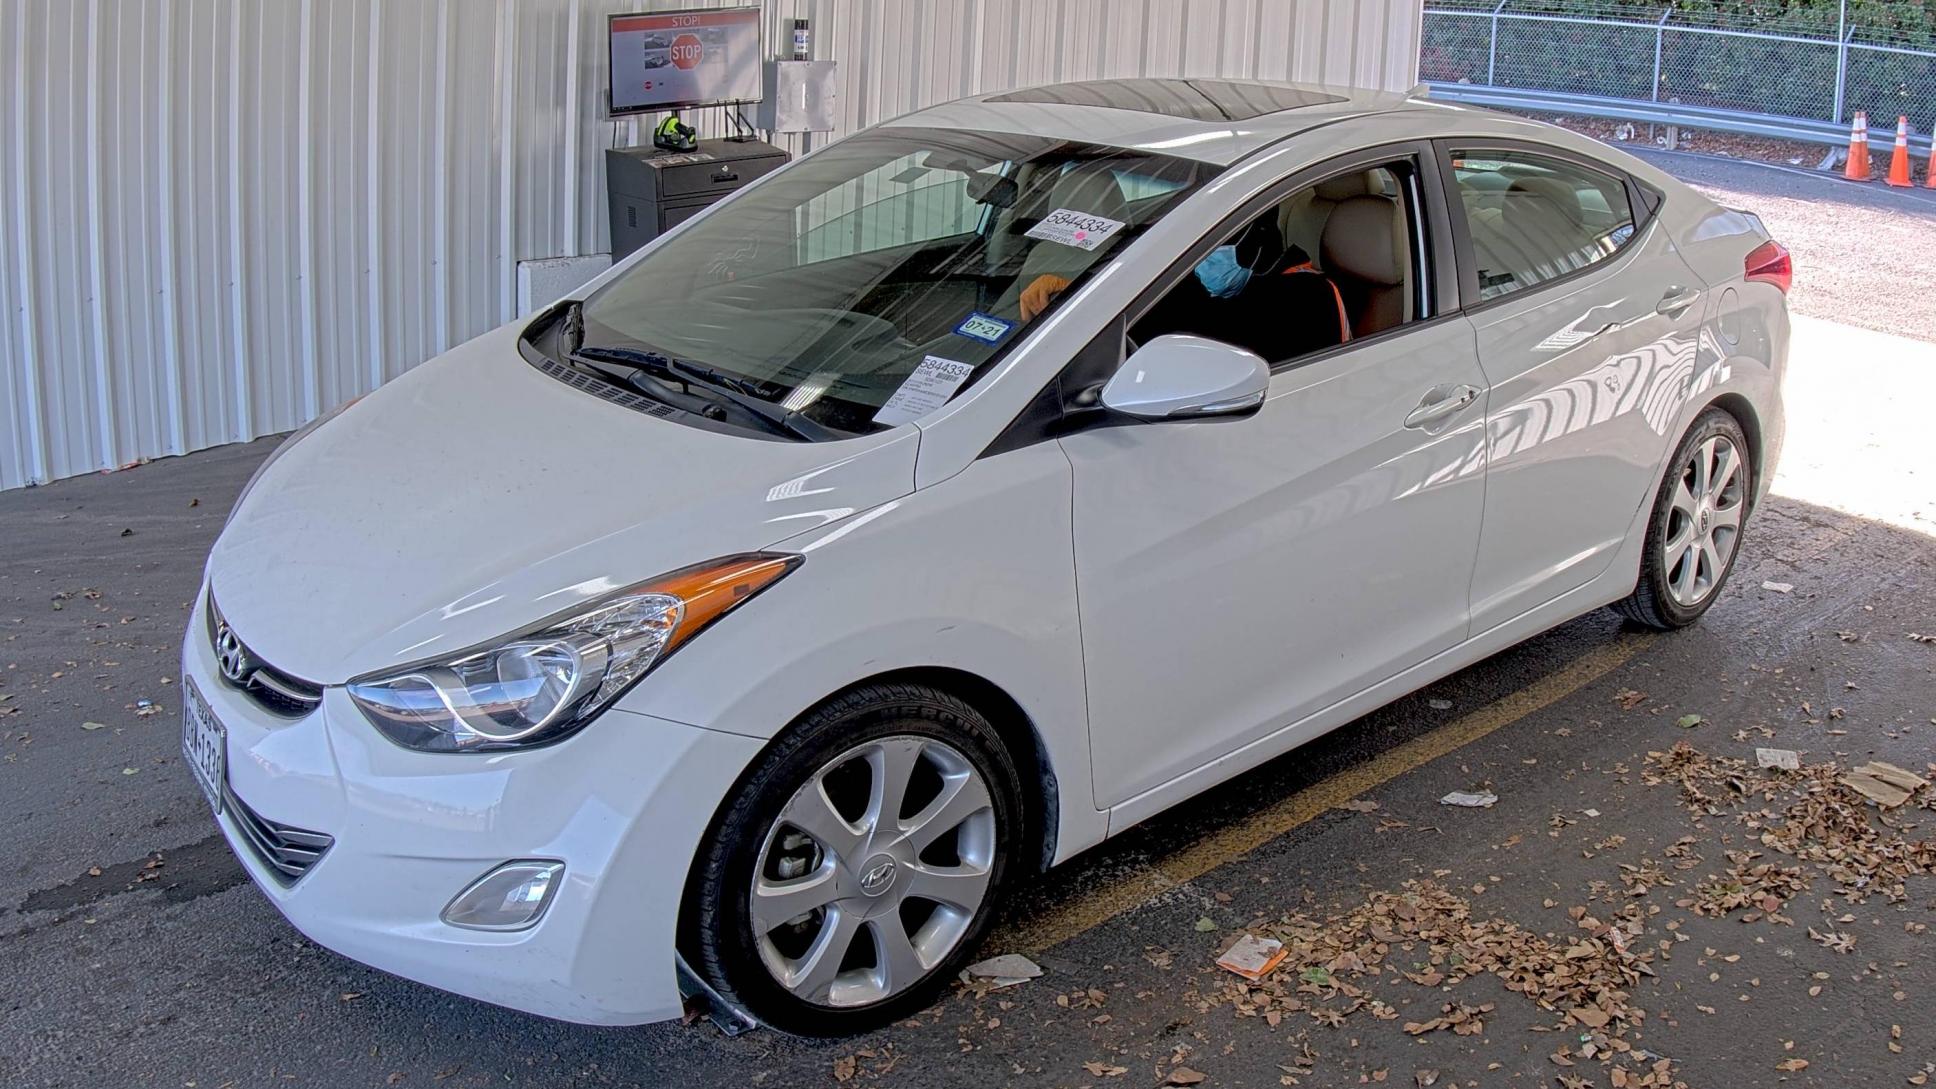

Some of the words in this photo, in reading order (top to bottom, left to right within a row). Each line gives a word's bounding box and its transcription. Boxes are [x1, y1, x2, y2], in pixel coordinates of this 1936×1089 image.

[672, 16, 700, 27] STOP!
[672, 45, 701, 60] STOP
[1046, 212, 1113, 234] 5844334
[920, 359, 971, 377] 5844334
